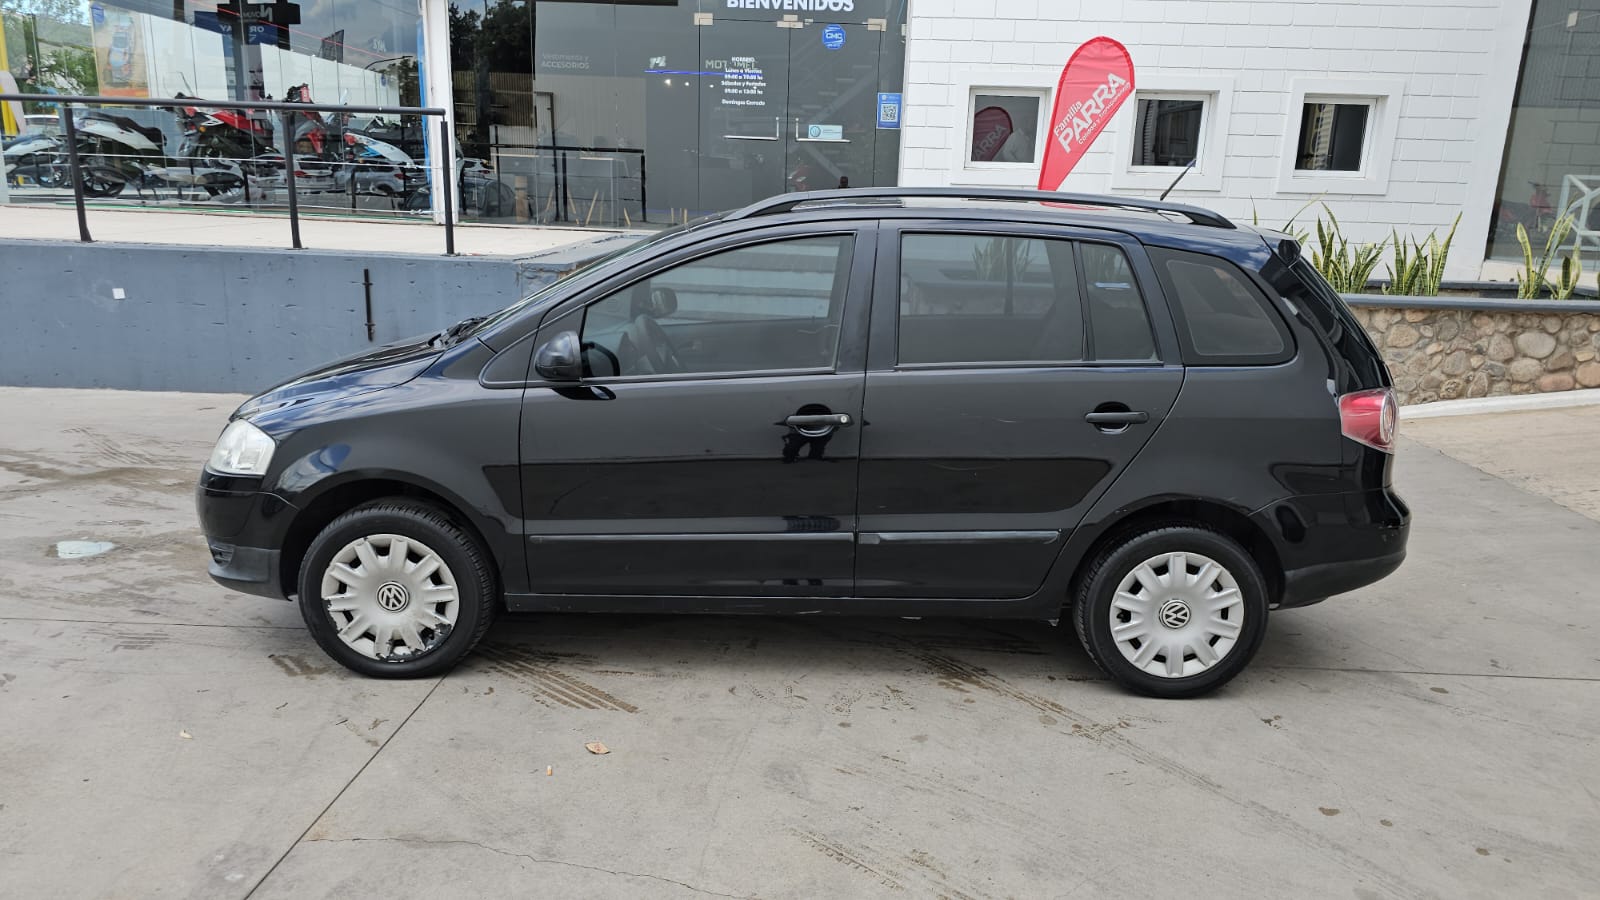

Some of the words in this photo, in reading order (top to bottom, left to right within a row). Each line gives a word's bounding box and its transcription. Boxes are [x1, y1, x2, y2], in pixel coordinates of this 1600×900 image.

[727, 0, 854, 12] BIENVENIDOS
[1054, 100, 1083, 137] Familia
[1058, 72, 1126, 154] PARRA
[974, 124, 1007, 158] ARRA
